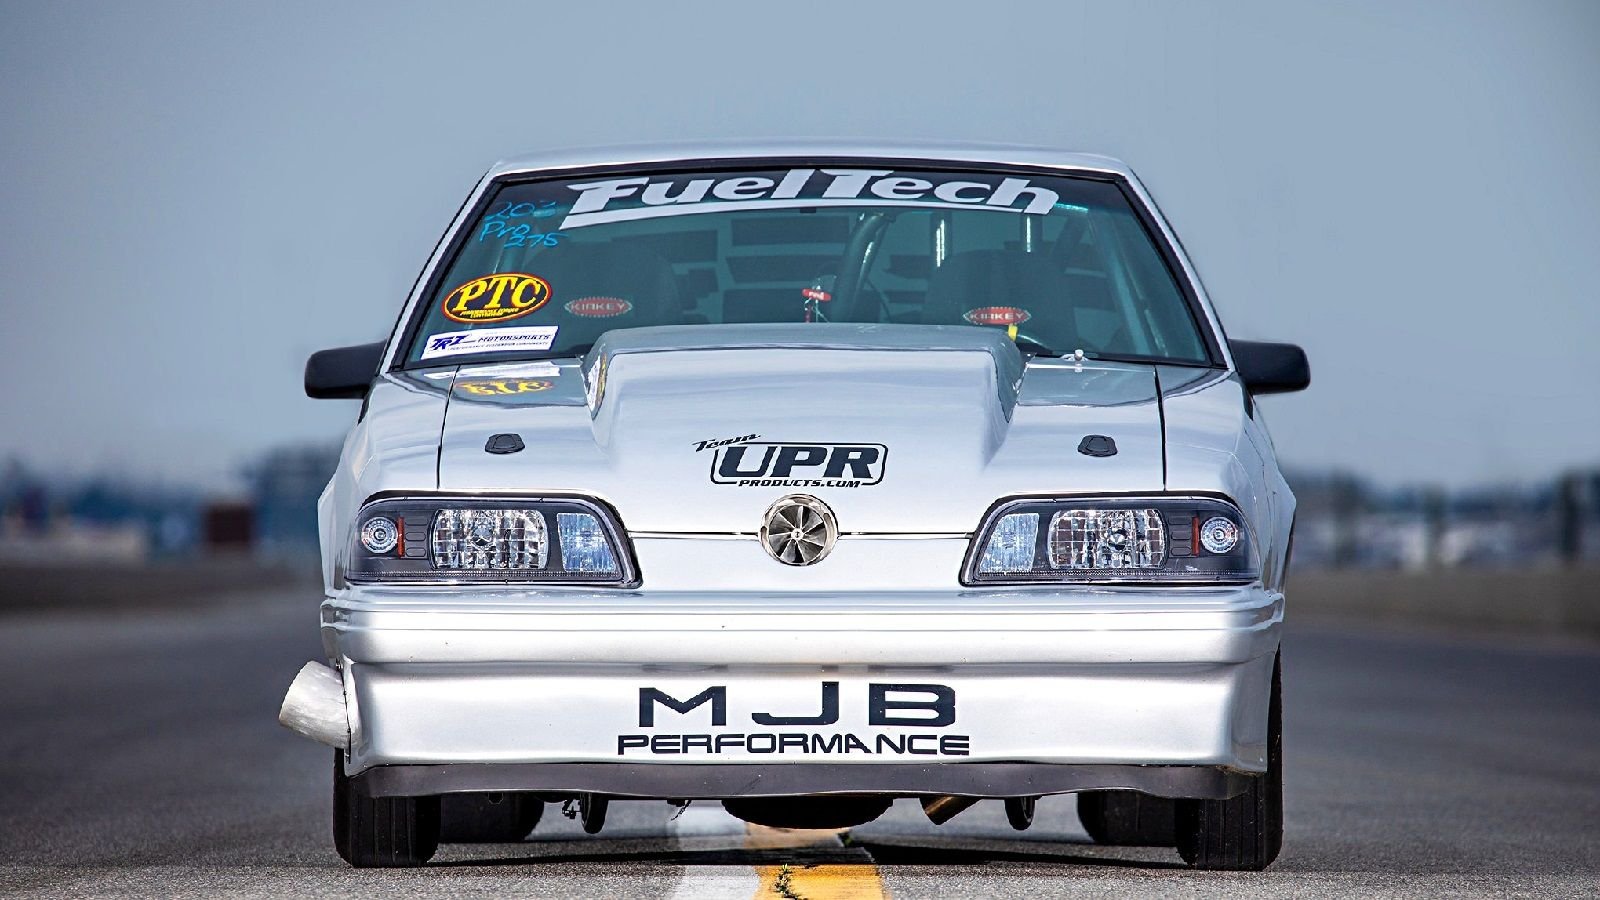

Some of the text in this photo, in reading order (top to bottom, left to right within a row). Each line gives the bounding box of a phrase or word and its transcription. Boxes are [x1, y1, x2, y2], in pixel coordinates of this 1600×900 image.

[566, 168, 1060, 216] FuelTech
[503, 232, 568, 250] 275
[452, 277, 541, 311] PTC
[718, 446, 880, 479] UPR
[738, 478, 861, 489] PRODUCTS.COM
[617, 732, 970, 756] PERFORMANCE
